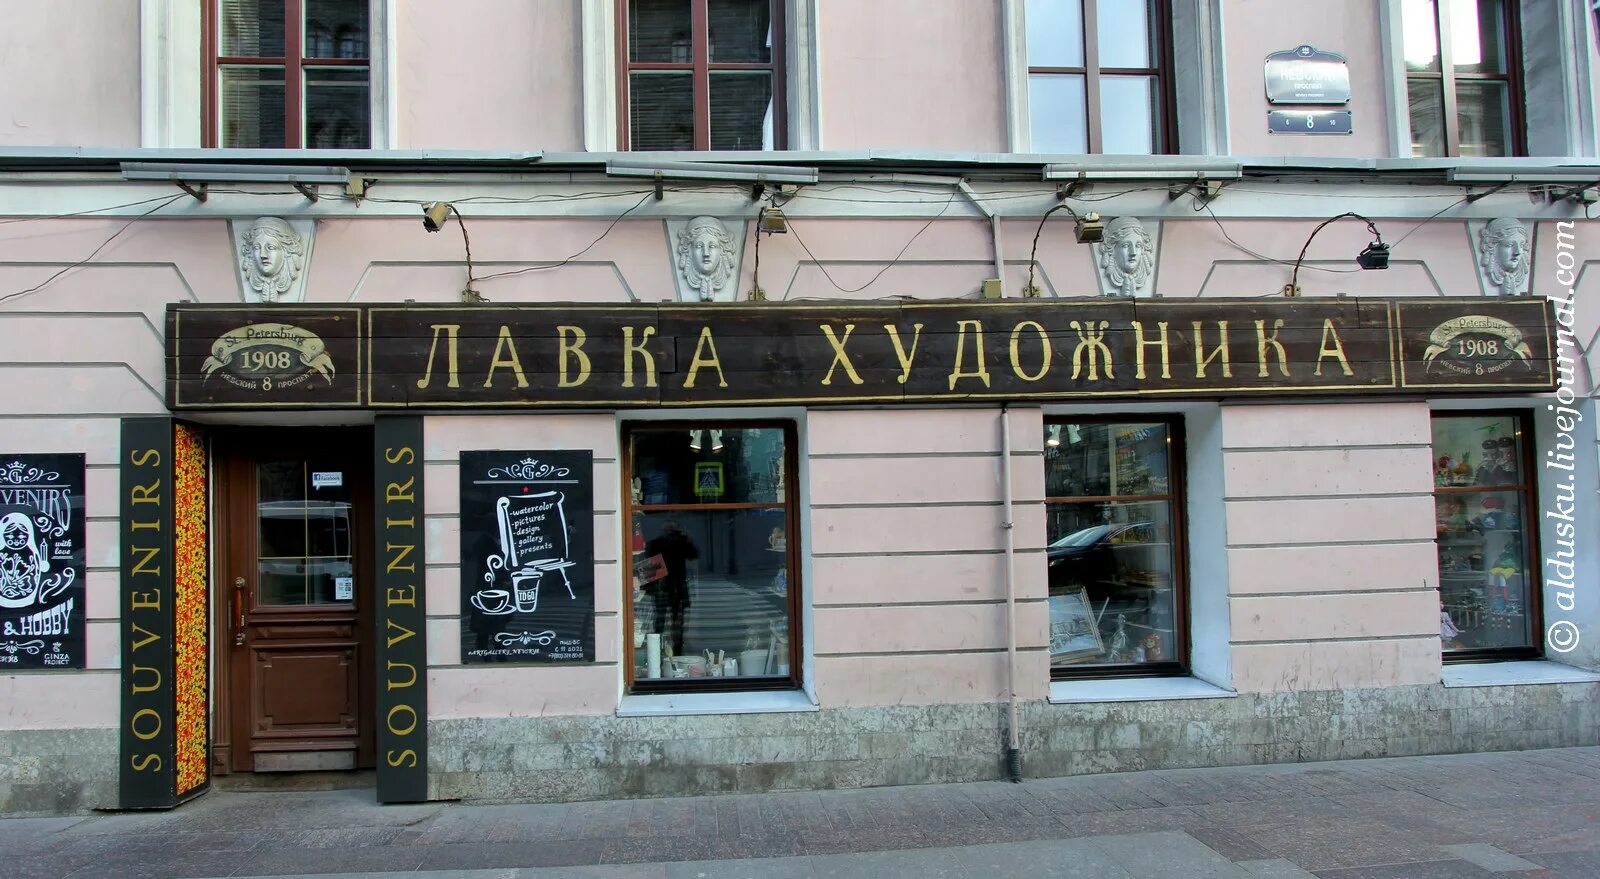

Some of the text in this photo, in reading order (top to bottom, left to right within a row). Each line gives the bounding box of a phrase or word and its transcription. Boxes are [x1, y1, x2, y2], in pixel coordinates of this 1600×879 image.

[1306, 114, 1314, 129] 8
[1459, 317, 1508, 334] Petersburg
[246, 327, 305, 346] Petersburg
[417, 318, 1355, 390] ЛАВКА ХУДОЖНИКА
[1457, 339, 1499, 357] 1908
[241, 351, 291, 372] 1908
[1440, 355, 1516, 376] НЕВСКИЙ 8 ПРОСПЕКТ
[220, 370, 315, 391] НЕВСКИЙ 8 ПРОСПЕКТ
[54, 539, 72, 547] with
[20, 597, 74, 635] HOBBY
[131, 448, 162, 772] SOUVENIRS
[385, 446, 417, 768] SOUVENIRS
